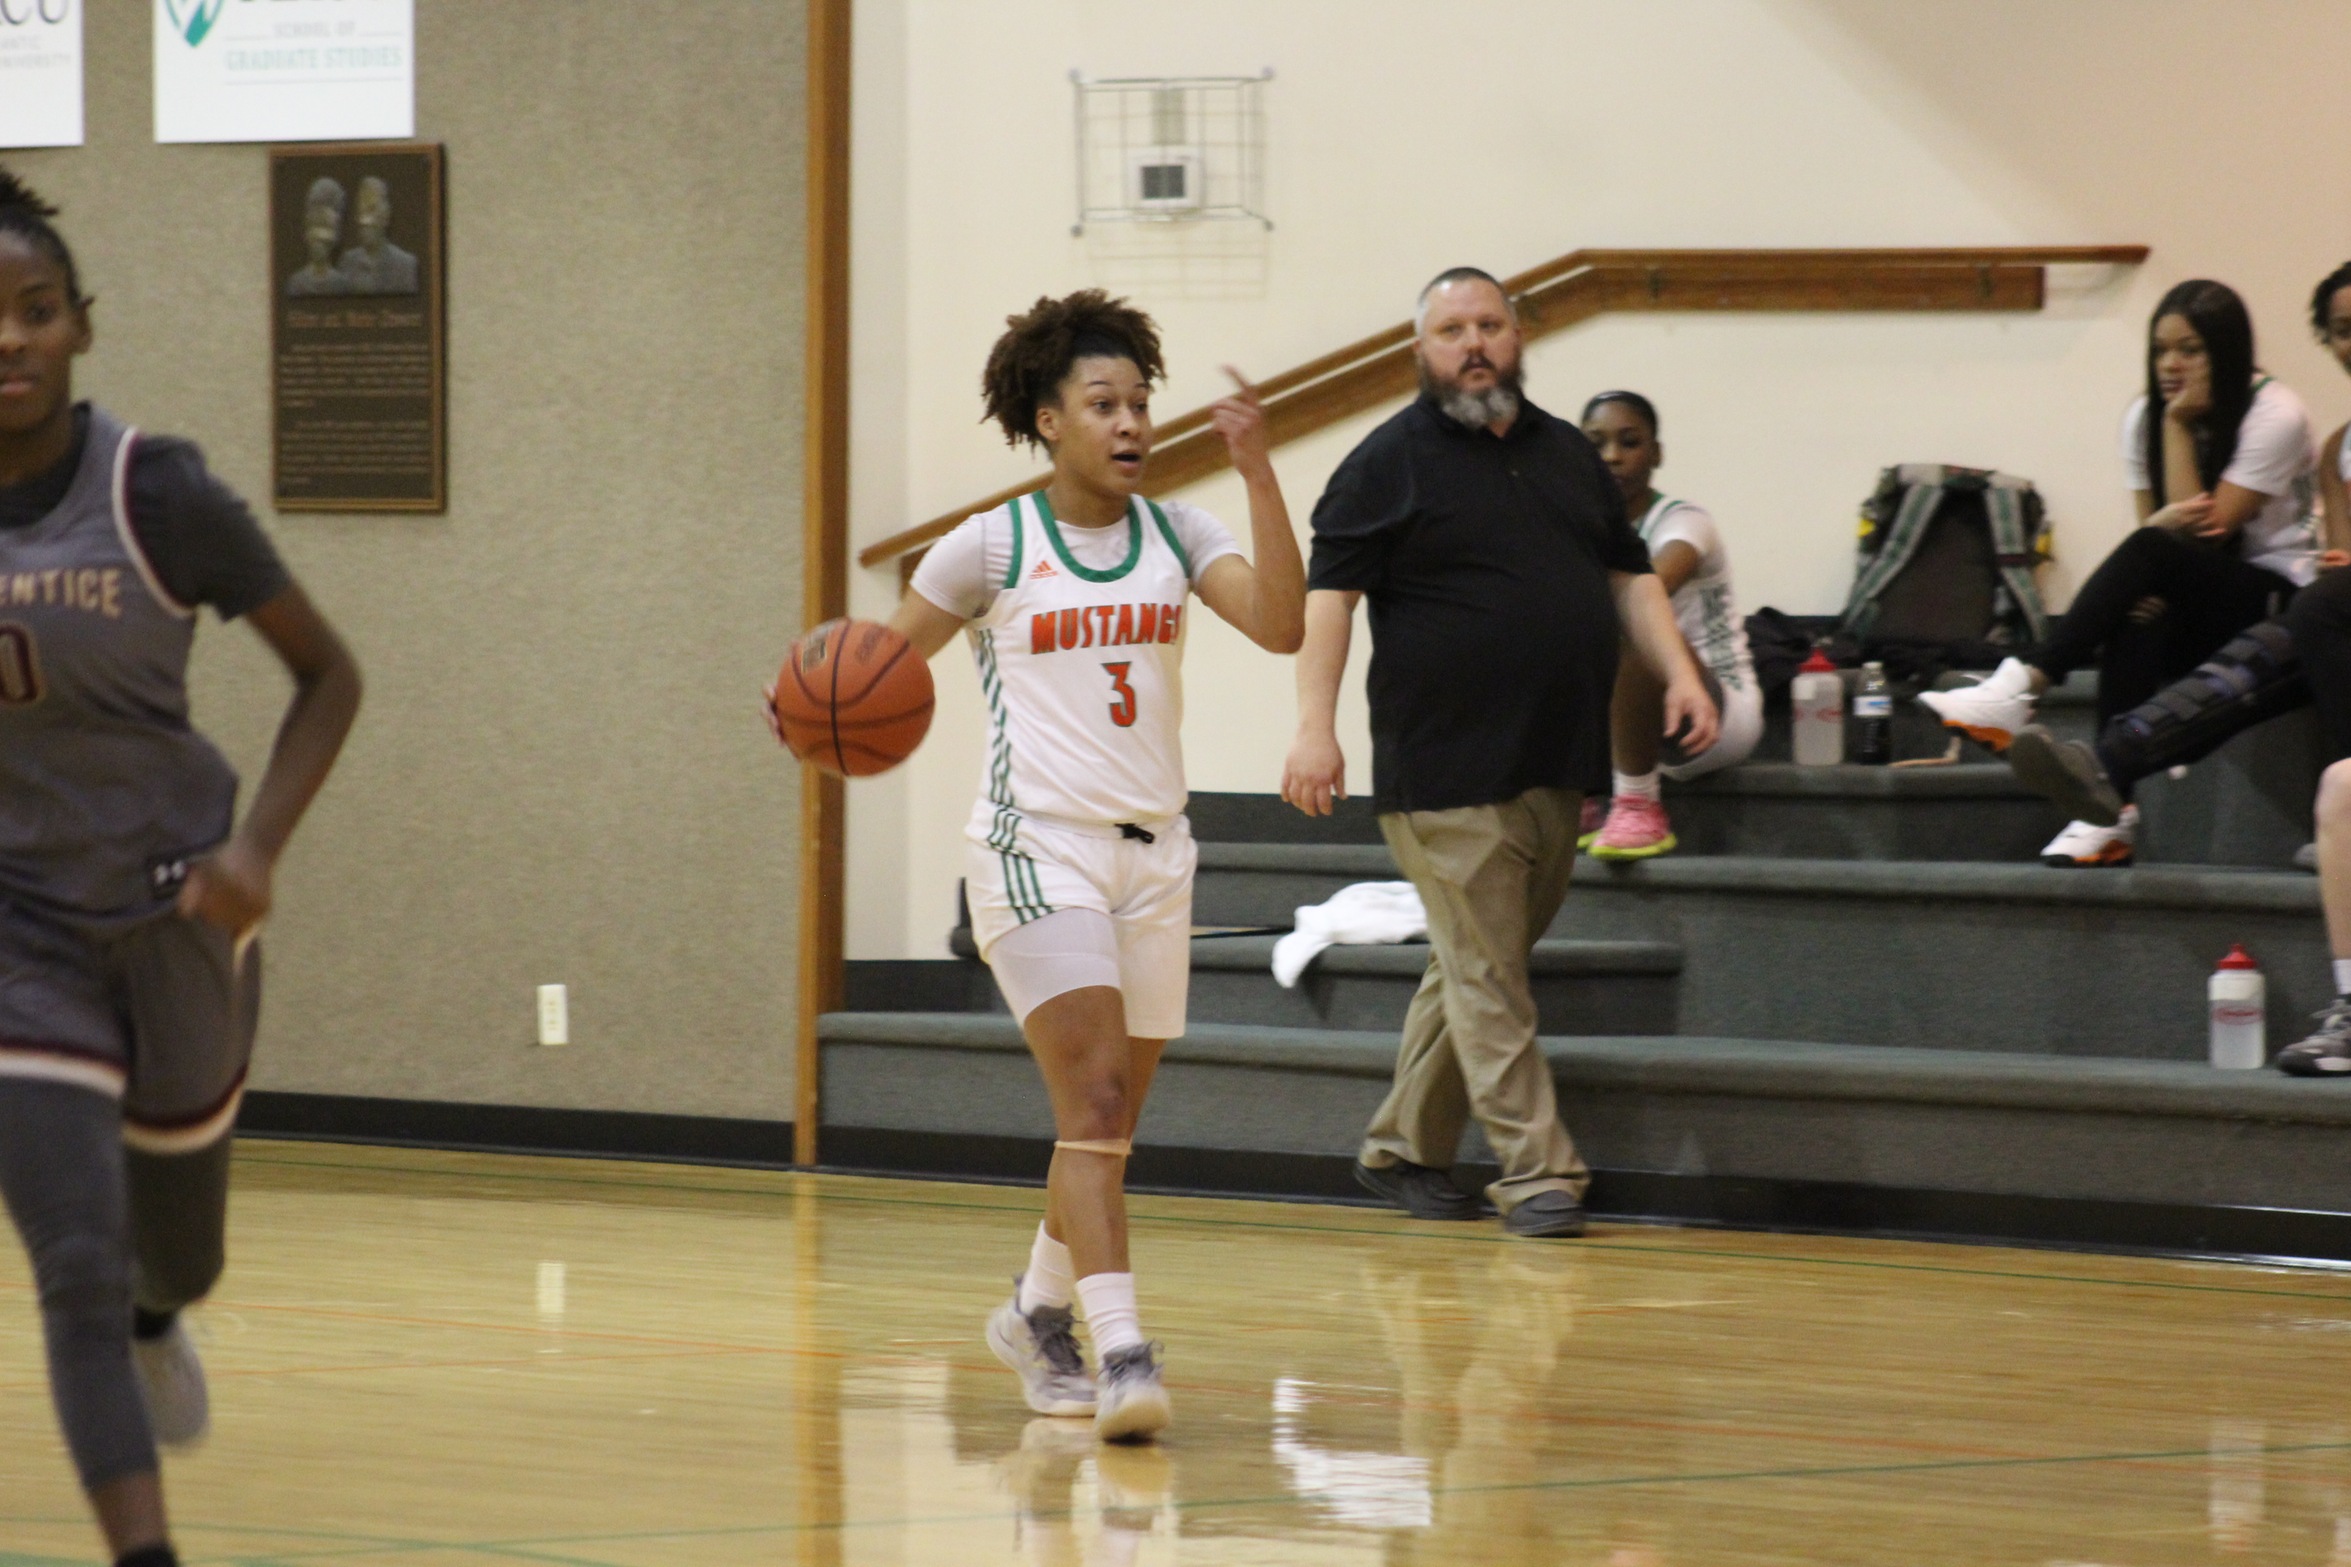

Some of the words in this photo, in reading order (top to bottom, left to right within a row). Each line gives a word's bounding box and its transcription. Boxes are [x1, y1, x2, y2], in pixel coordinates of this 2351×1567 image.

[226, 48, 318, 71] GRADUATE
[323, 45, 402, 69] STUDIES
[1101, 661, 1136, 727] 3
